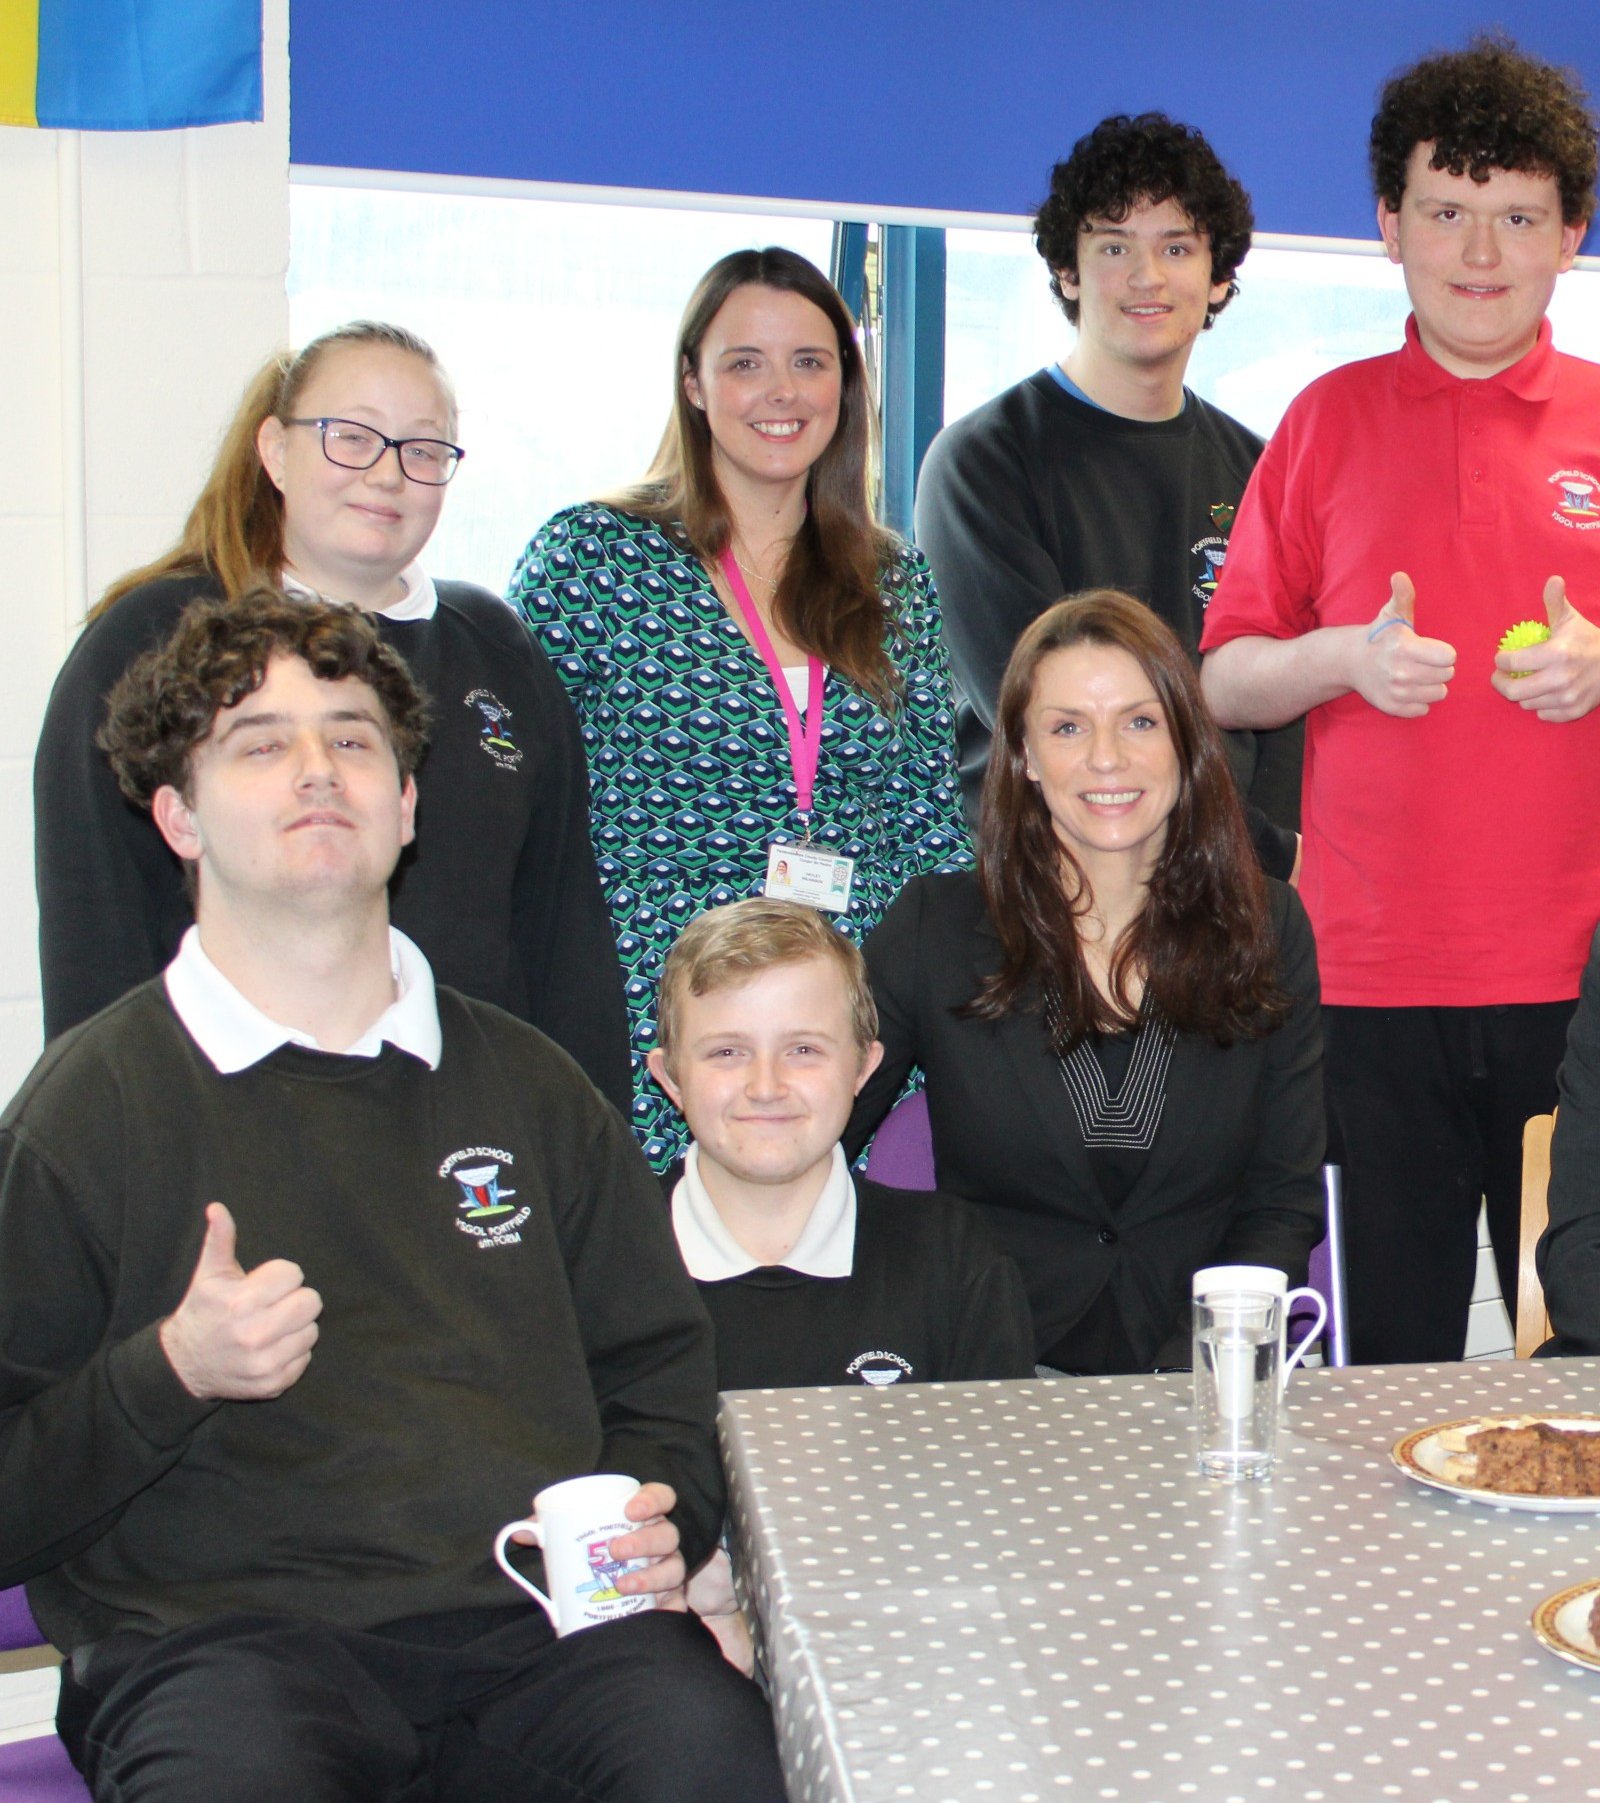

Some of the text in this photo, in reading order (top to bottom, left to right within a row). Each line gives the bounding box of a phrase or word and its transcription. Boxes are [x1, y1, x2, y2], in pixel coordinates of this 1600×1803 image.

[1552, 511, 1574, 528] YSGOL
[1191, 537, 1222, 555] PORTFIELD
[438, 1147, 514, 1178] PORTFIELD SCHOOL
[455, 1206, 531, 1237] YSGOL PORTFIELD
[494, 1232, 522, 1246] FORM
[846, 1351, 913, 1375] PORTFIELD SCHOOL
